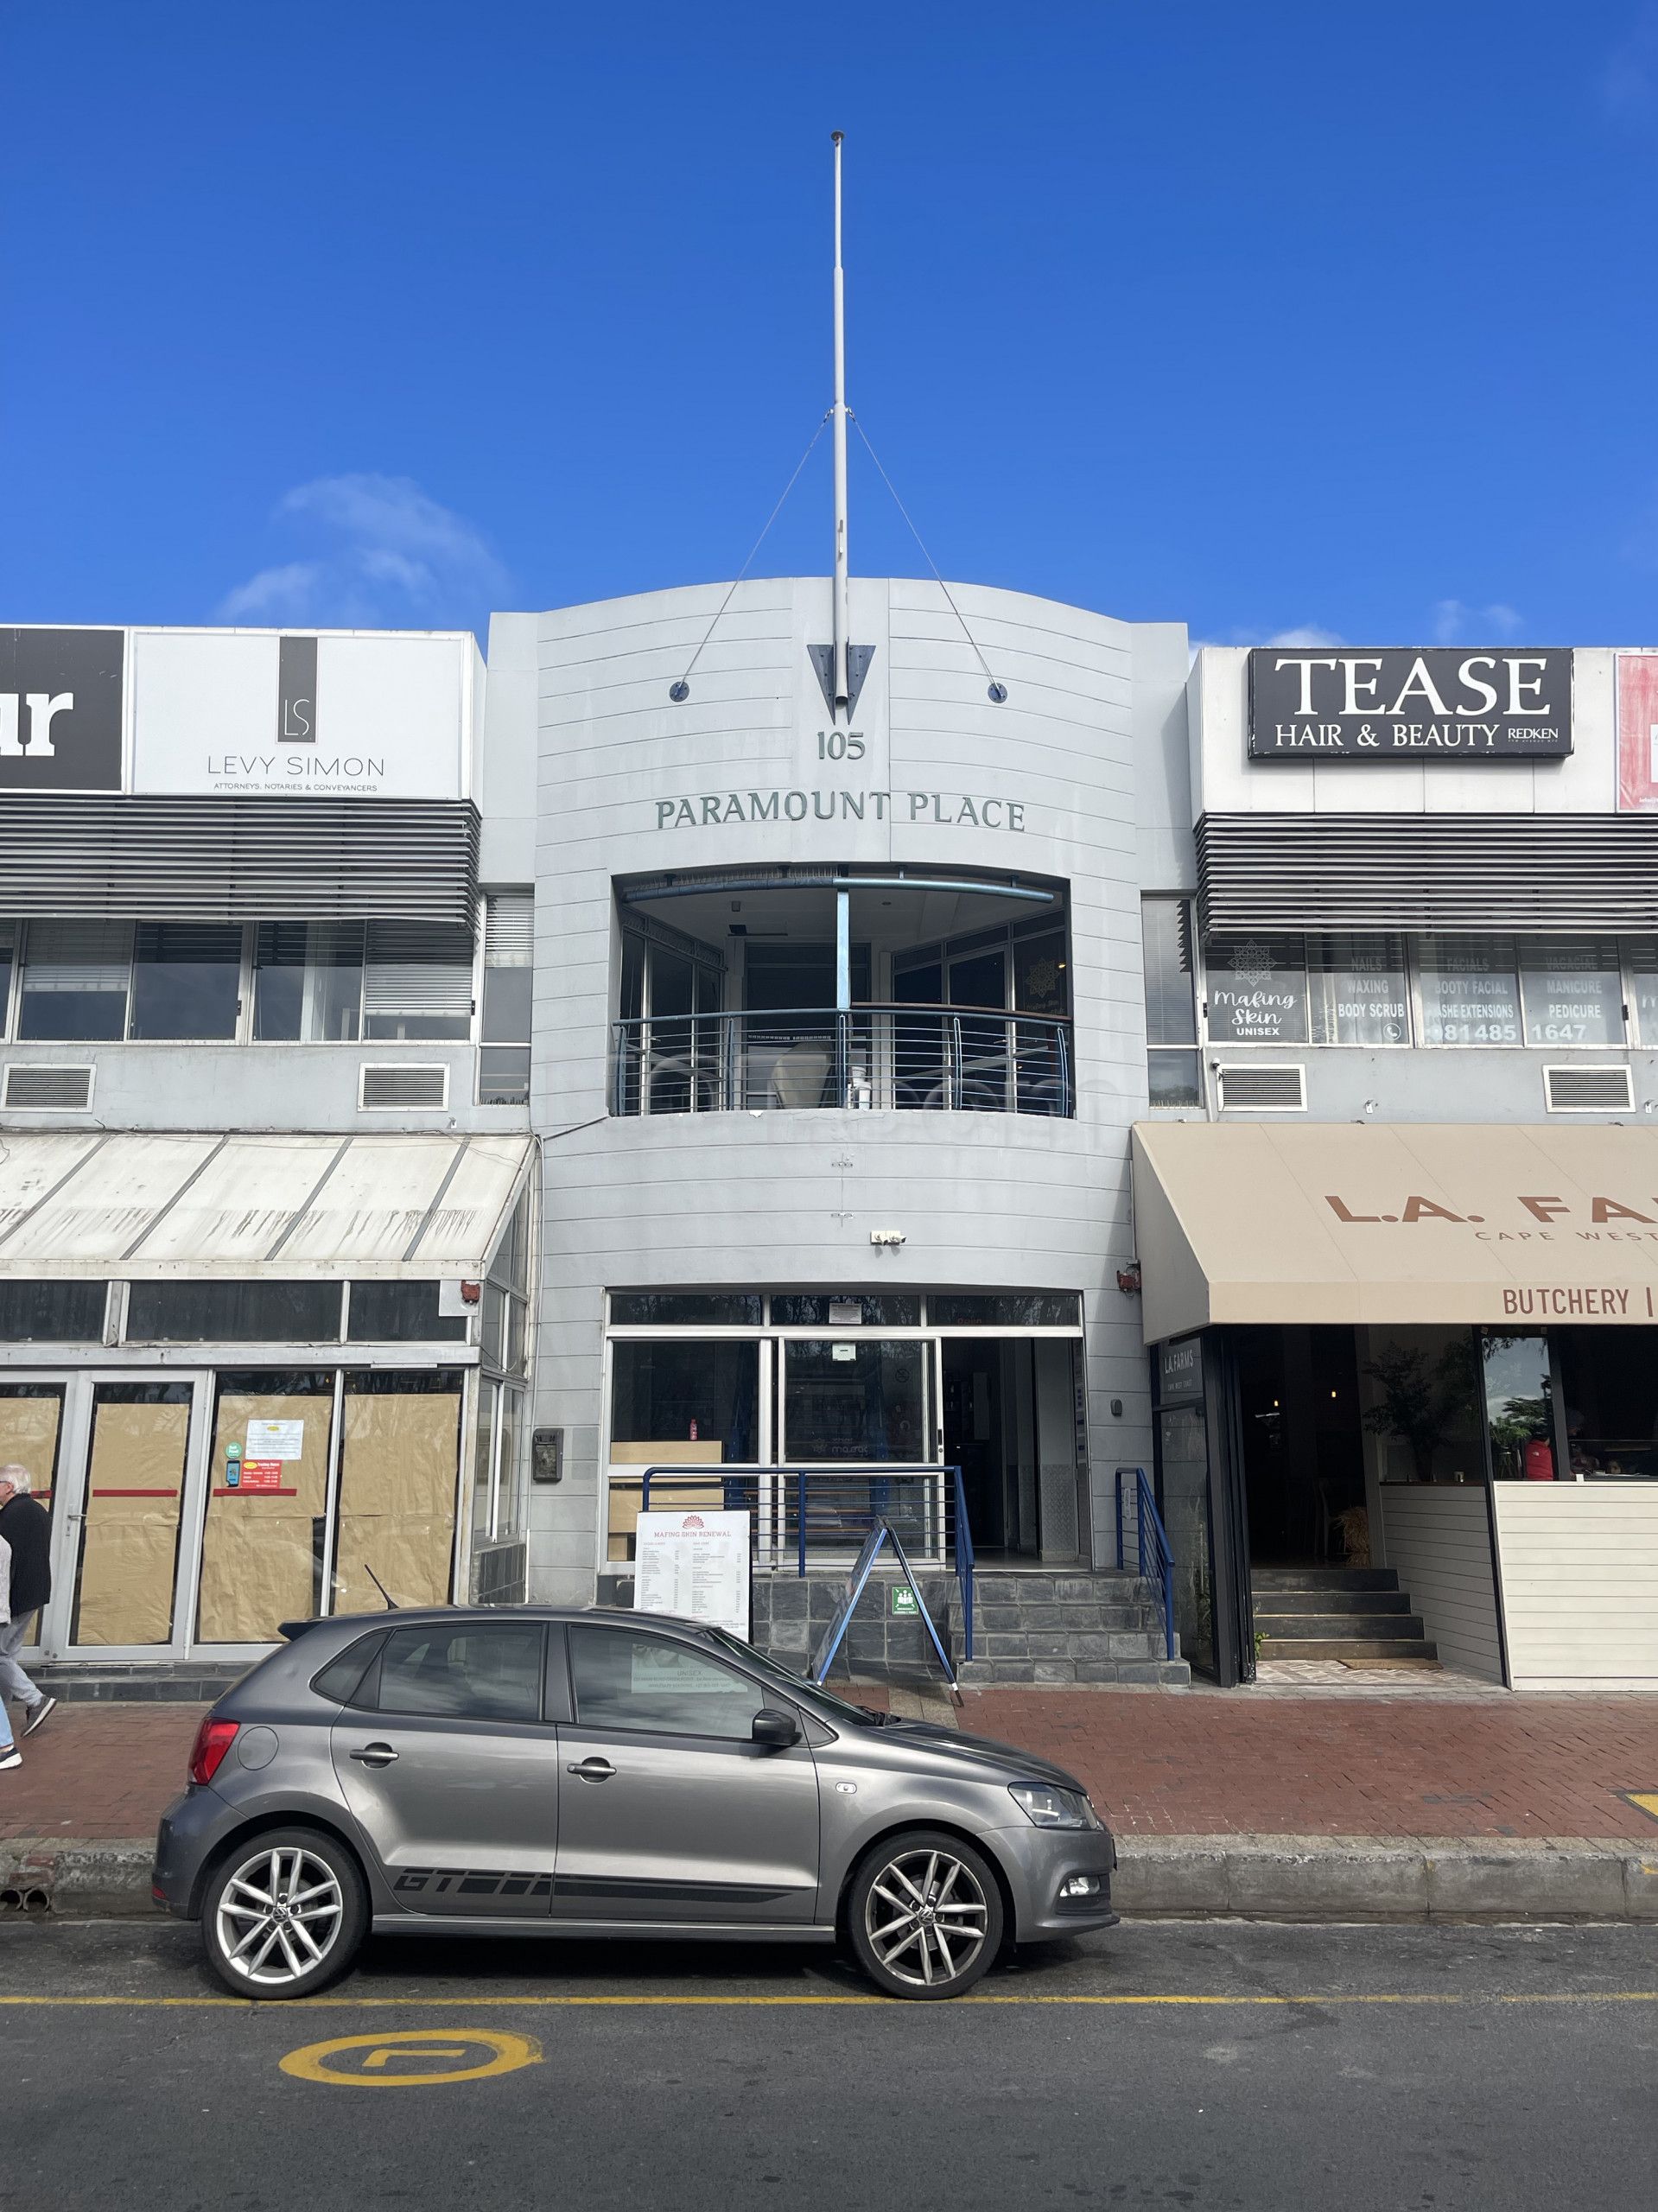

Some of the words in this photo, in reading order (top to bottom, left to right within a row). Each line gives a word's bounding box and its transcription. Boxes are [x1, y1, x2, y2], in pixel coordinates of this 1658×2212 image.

[1274, 657, 1551, 716] TEASE
[284, 698, 310, 736] LS
[1274, 724, 1344, 747] HAIR
[1356, 725, 1380, 747] &
[1392, 723, 1500, 747] BEAUTY
[1508, 728, 1559, 739] REDKEN
[816, 731, 866, 760] 105
[207, 755, 276, 774] LEVY
[286, 756, 384, 777] SIMON
[314, 784, 378, 792] CONVEYANCERS
[655, 791, 891, 830] PARAMOUNT
[906, 791, 1026, 832] PLACE
[1350, 957, 1383, 972] NAILS
[1445, 957, 1490, 972] FACIALS
[1347, 980, 1389, 995] WAXING
[1472, 980, 1509, 995] FACIAL
[1546, 979, 1603, 995] MANICURE
[1338, 1003, 1366, 1018] BODY
[1369, 1003, 1405, 1018] SCRUB
[1430, 1003, 1459, 1019] ASHE
[1461, 1003, 1515, 1019] EXTENSIONS
[1548, 1003, 1602, 1019] PEDICURE
[1236, 1027, 1280, 1036] UNISEX
[1474, 1024, 1517, 1041] 485
[1531, 1023, 1587, 1041] 1647
[1324, 1195, 1485, 1223] L.A.
[1516, 1196, 1658, 1224] FA
[1474, 1231, 1555, 1242] CAPE
[1575, 1231, 1658, 1242] WEST
[1503, 1287, 1629, 1315] BUTCHERY
